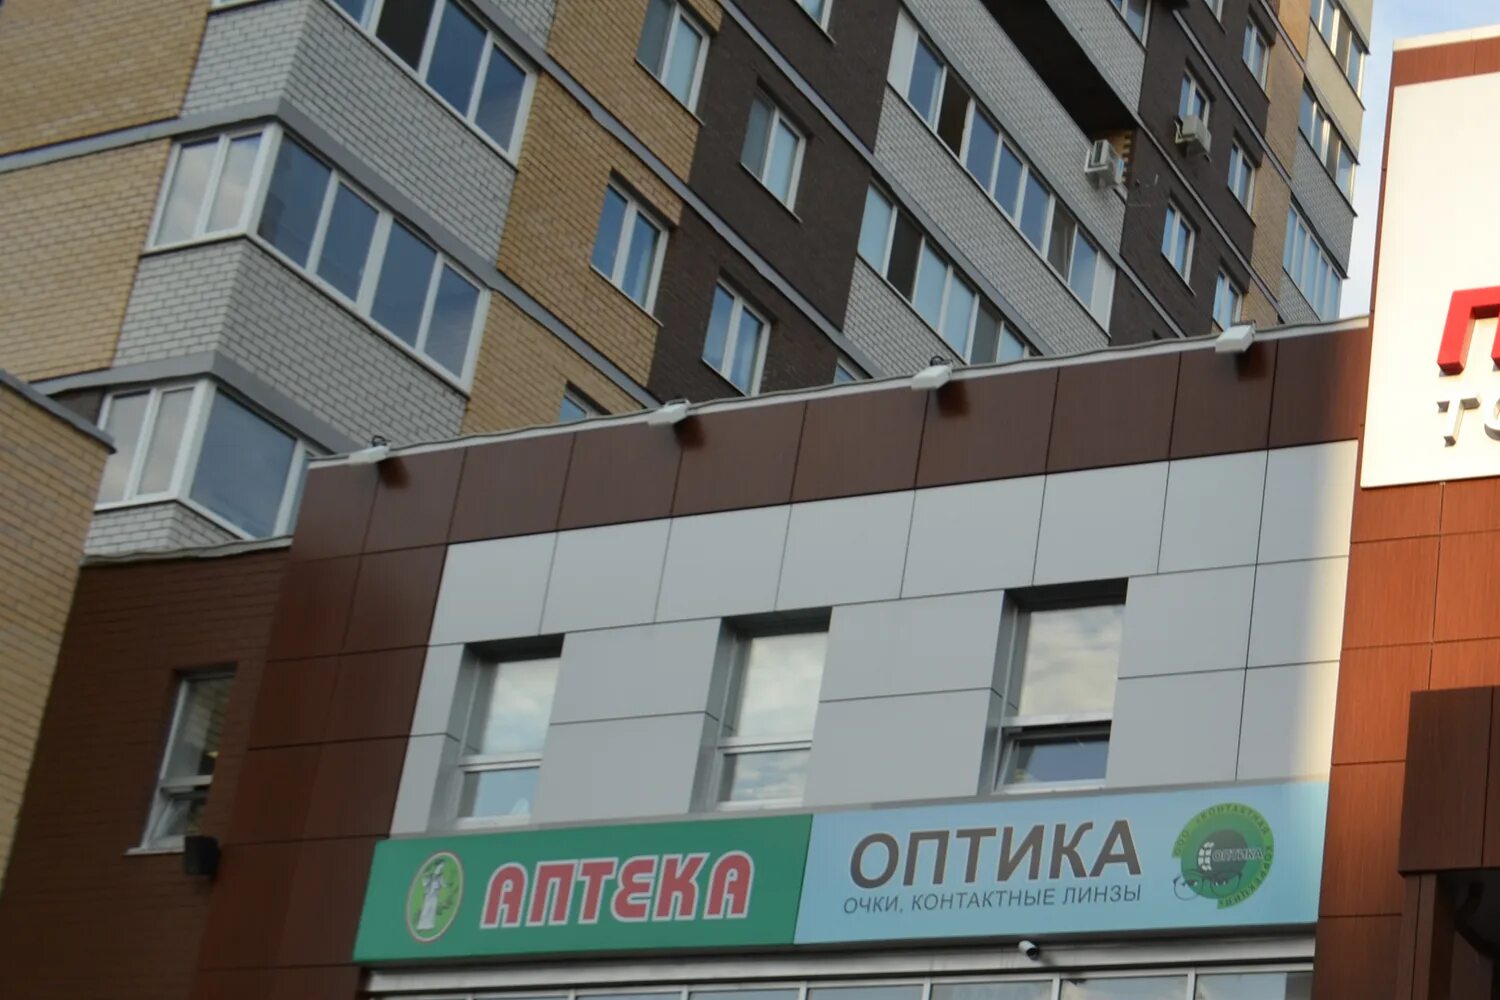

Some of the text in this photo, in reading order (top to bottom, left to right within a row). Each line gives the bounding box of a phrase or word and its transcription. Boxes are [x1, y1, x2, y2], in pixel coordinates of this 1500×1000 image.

[850, 820, 1142, 889] ОПТИКА
[480, 850, 755, 930] АПТЕКА
[843, 884, 1142, 915] ОЧКИ, КОНТАКТНЫЕ ЛИНЗЫ
